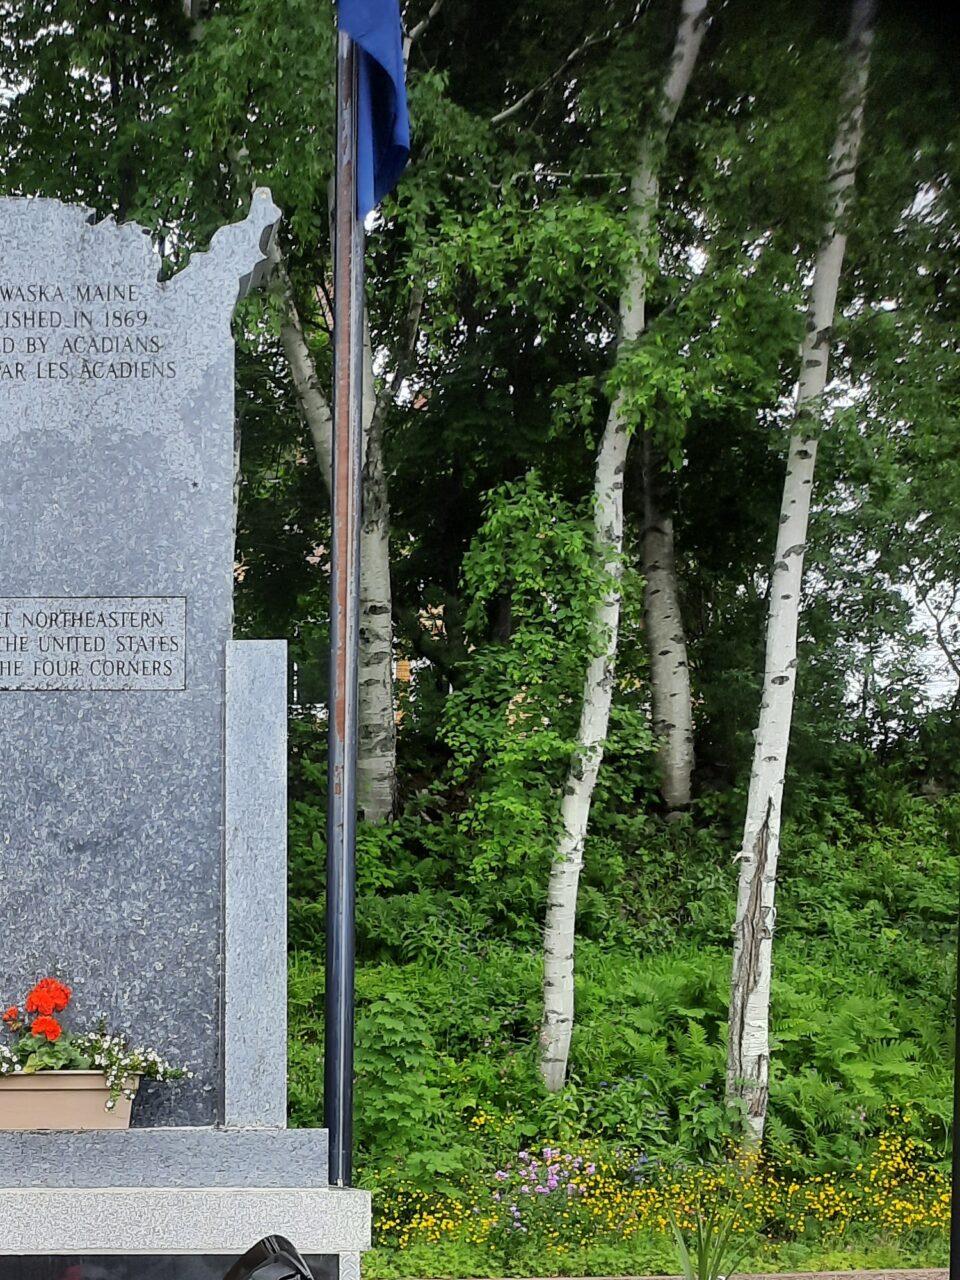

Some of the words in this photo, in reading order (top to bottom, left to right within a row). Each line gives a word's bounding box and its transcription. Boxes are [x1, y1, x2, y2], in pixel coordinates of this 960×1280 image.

[76, 285, 140, 302] MAINE
[73, 311, 92, 327] IN
[104, 310, 148, 327] 1869
[26, 337, 48, 353] BY
[62, 336, 161, 353] ACADIANS
[36, 362, 68, 379] LES
[81, 361, 177, 379] ACADIENS
[22, 611, 165, 628] NORTHEASTERN
[39, 635, 106, 652] UNITED
[116, 635, 180, 652] STATES
[33, 660, 81, 677] FOUR
[89, 659, 174, 677] CORNERS
